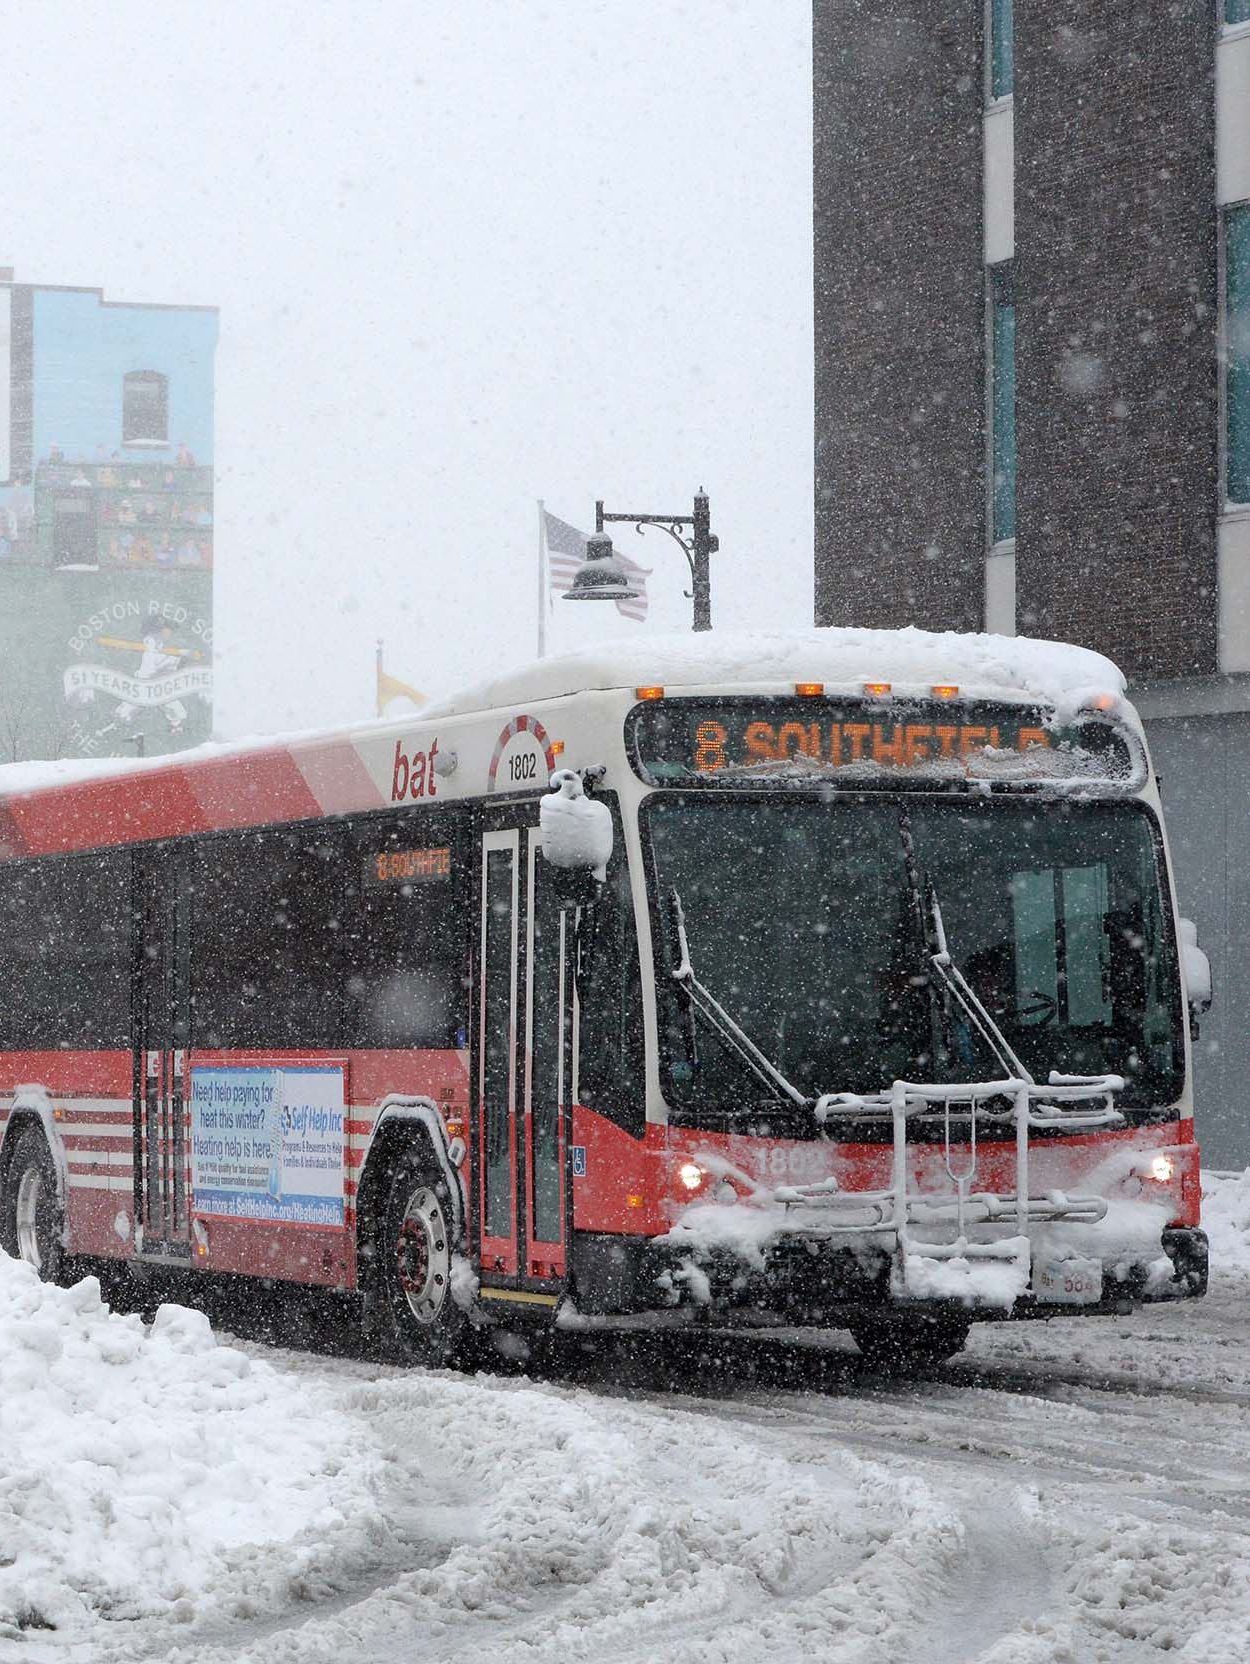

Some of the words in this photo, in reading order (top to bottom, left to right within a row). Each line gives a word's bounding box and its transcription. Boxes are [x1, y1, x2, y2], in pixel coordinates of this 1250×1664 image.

[68, 600, 141, 656] BOSTON
[149, 600, 188, 622] RED
[71, 671, 87, 686] 51
[92, 671, 142, 698] YEARS
[696, 719, 727, 772] 8
[391, 737, 439, 801] bat
[509, 752, 536, 780] 1802
[193, 1081, 213, 1101] Need
[215, 1081, 231, 1104] help
[234, 1081, 260, 1107] paying
[262, 1081, 274, 1102] for
[200, 1107, 217, 1128] heat
[219, 1107, 234, 1128] this
[235, 1108, 265, 1129] winter?
[292, 1105, 309, 1138] Self
[309, 1106, 328, 1138] Help
[329, 1107, 342, 1131] Inc
[193, 1135, 223, 1161] Heating
[225, 1136, 242, 1161] help
[244, 1136, 251, 1157] is
[253, 1137, 273, 1159] here.
